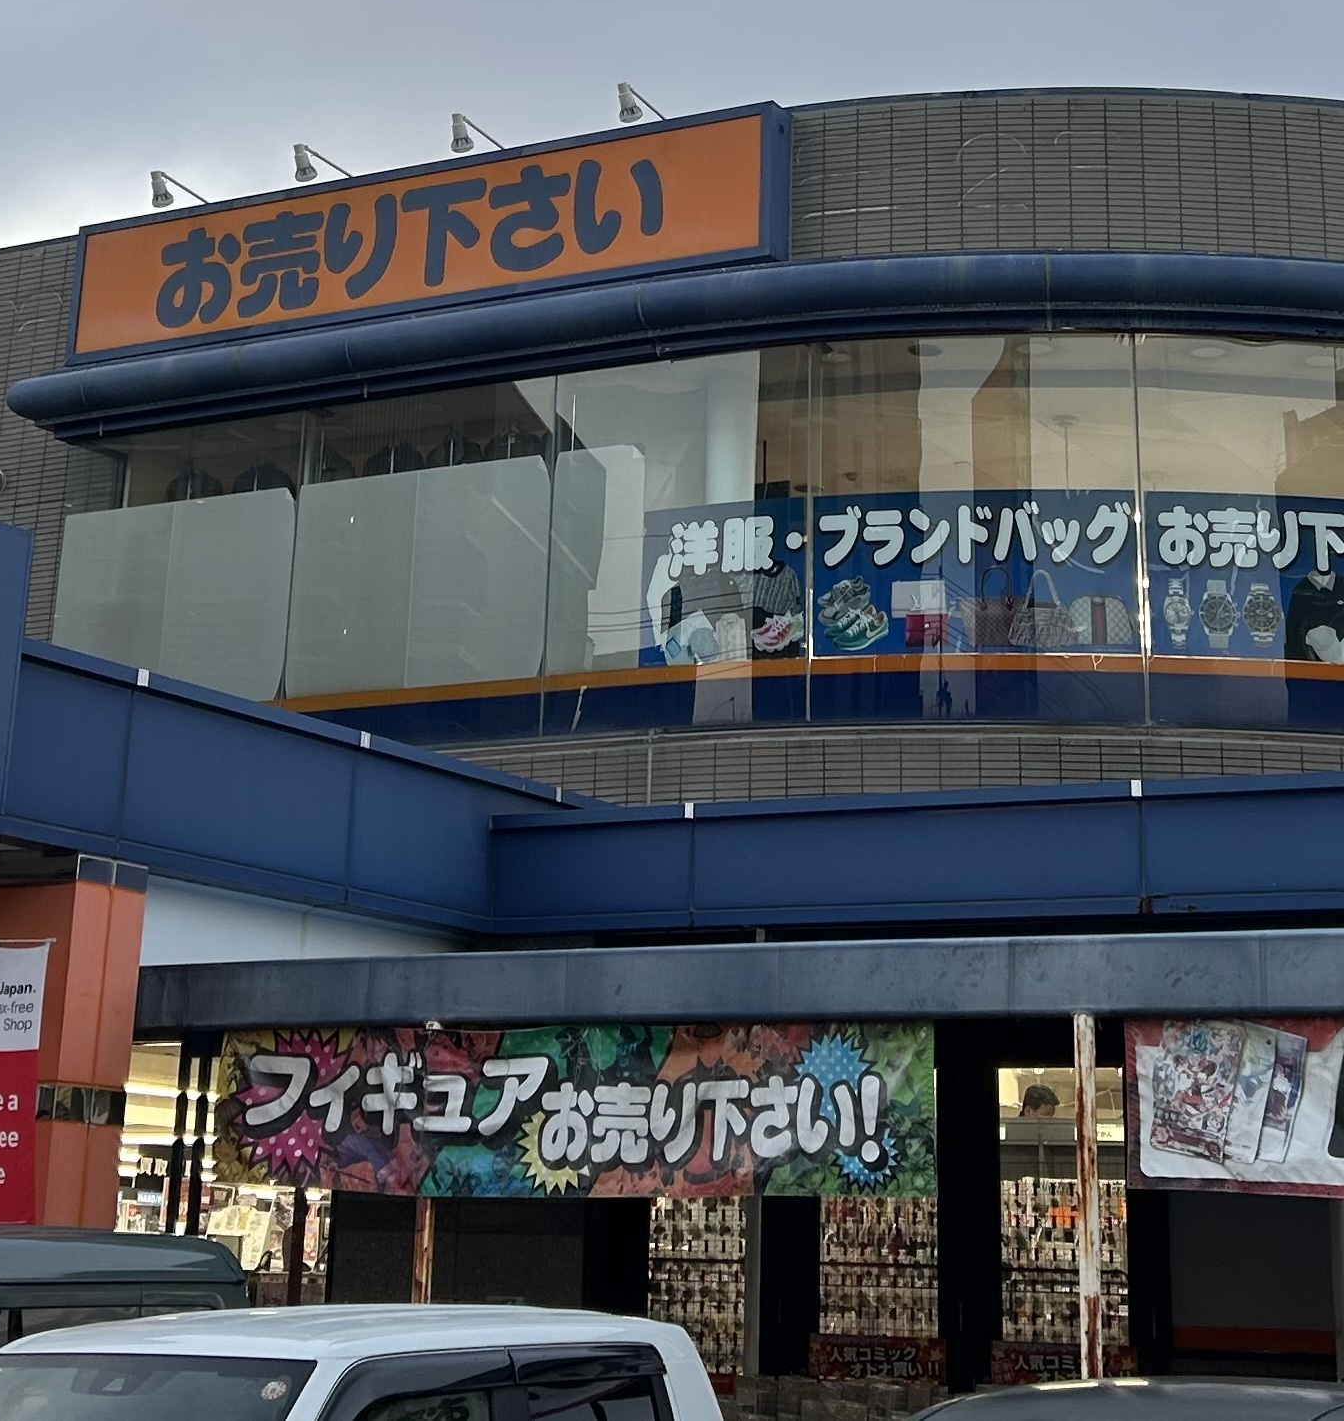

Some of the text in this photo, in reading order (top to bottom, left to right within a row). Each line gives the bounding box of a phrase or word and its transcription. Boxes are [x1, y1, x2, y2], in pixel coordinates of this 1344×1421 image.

[155, 158, 664, 329] お売り下さい
[3, 1018, 33, 1033] Shop
[7, 1094, 19, 1111] a
[244, 1051, 882, 1165] フィギュア お売り下さい!
[829, 1346, 917, 1363] 人気コミック
[1014, 1354, 1106, 1371] 人気コミ
